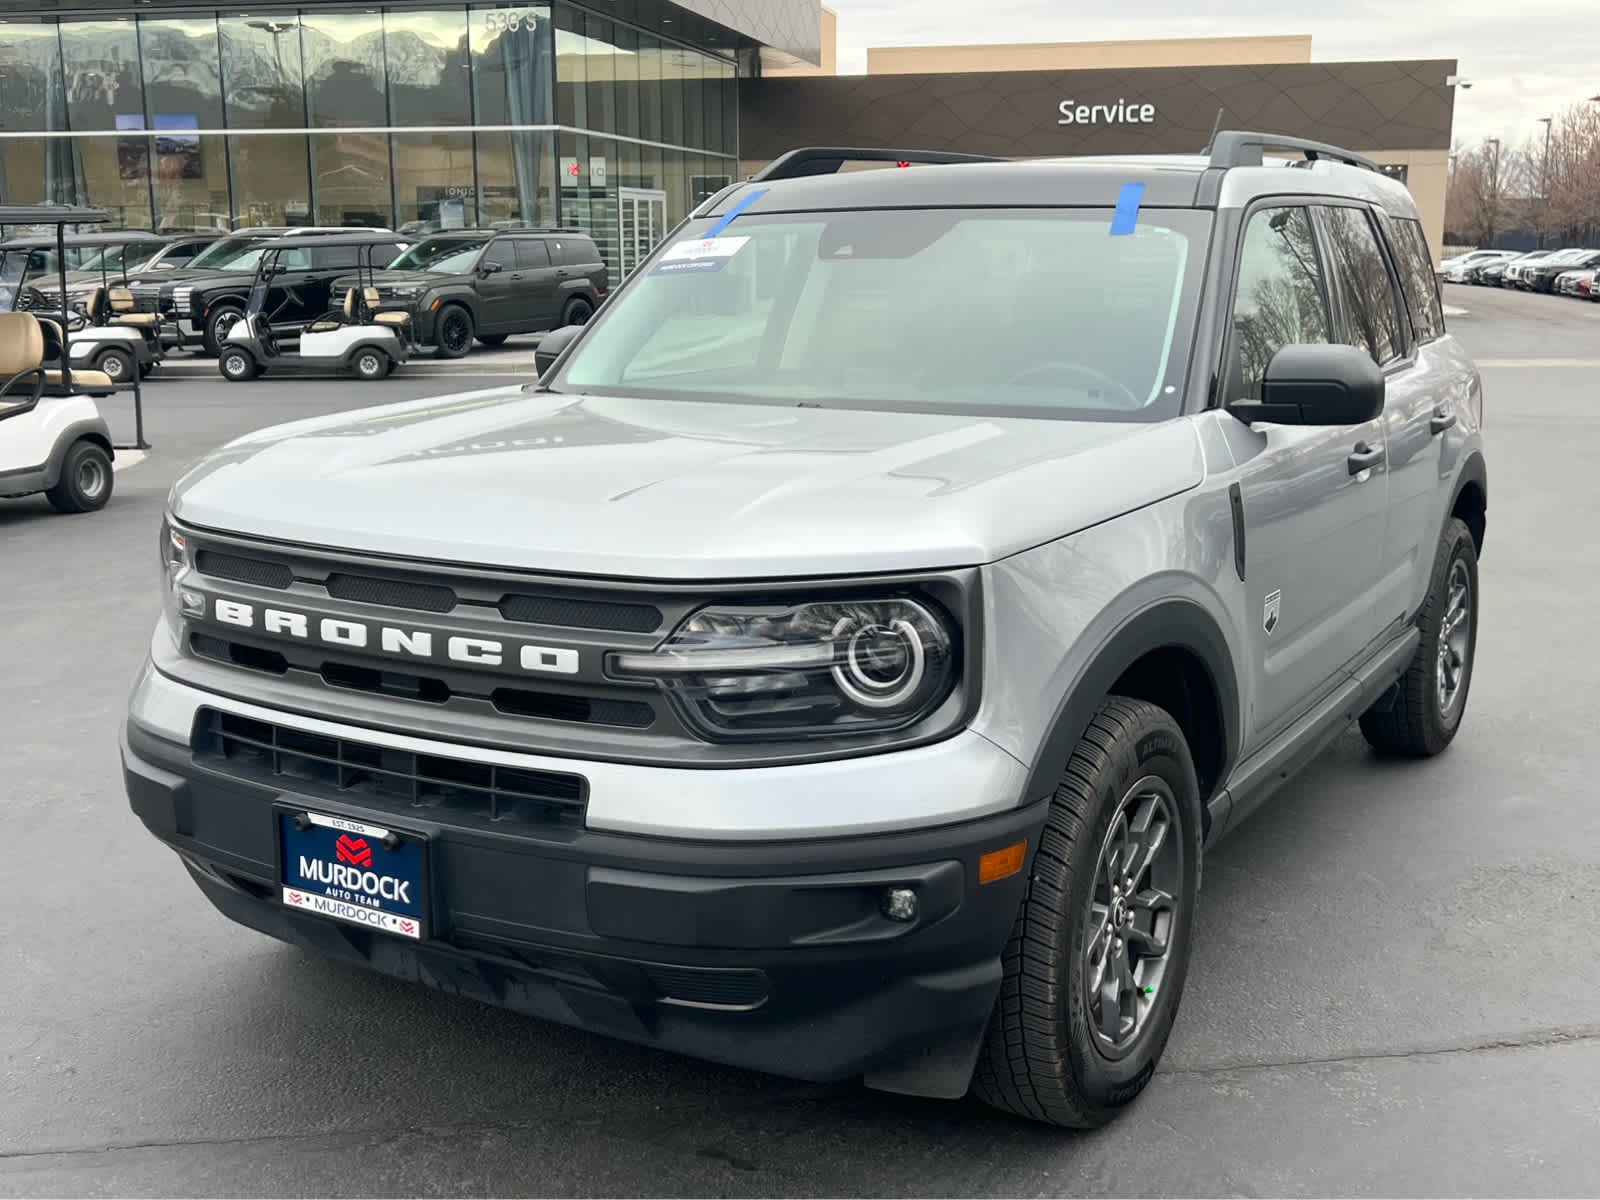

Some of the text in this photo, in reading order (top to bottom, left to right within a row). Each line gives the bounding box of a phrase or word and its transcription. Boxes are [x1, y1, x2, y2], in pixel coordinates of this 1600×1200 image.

[526, 11, 537, 31] S
[1058, 98, 1155, 124] Service
[215, 599, 579, 674] BRONCO
[300, 856, 411, 904] MURDOCK
[325, 887, 380, 907] AUTO TEAM
[314, 897, 388, 927] MURDOCK
